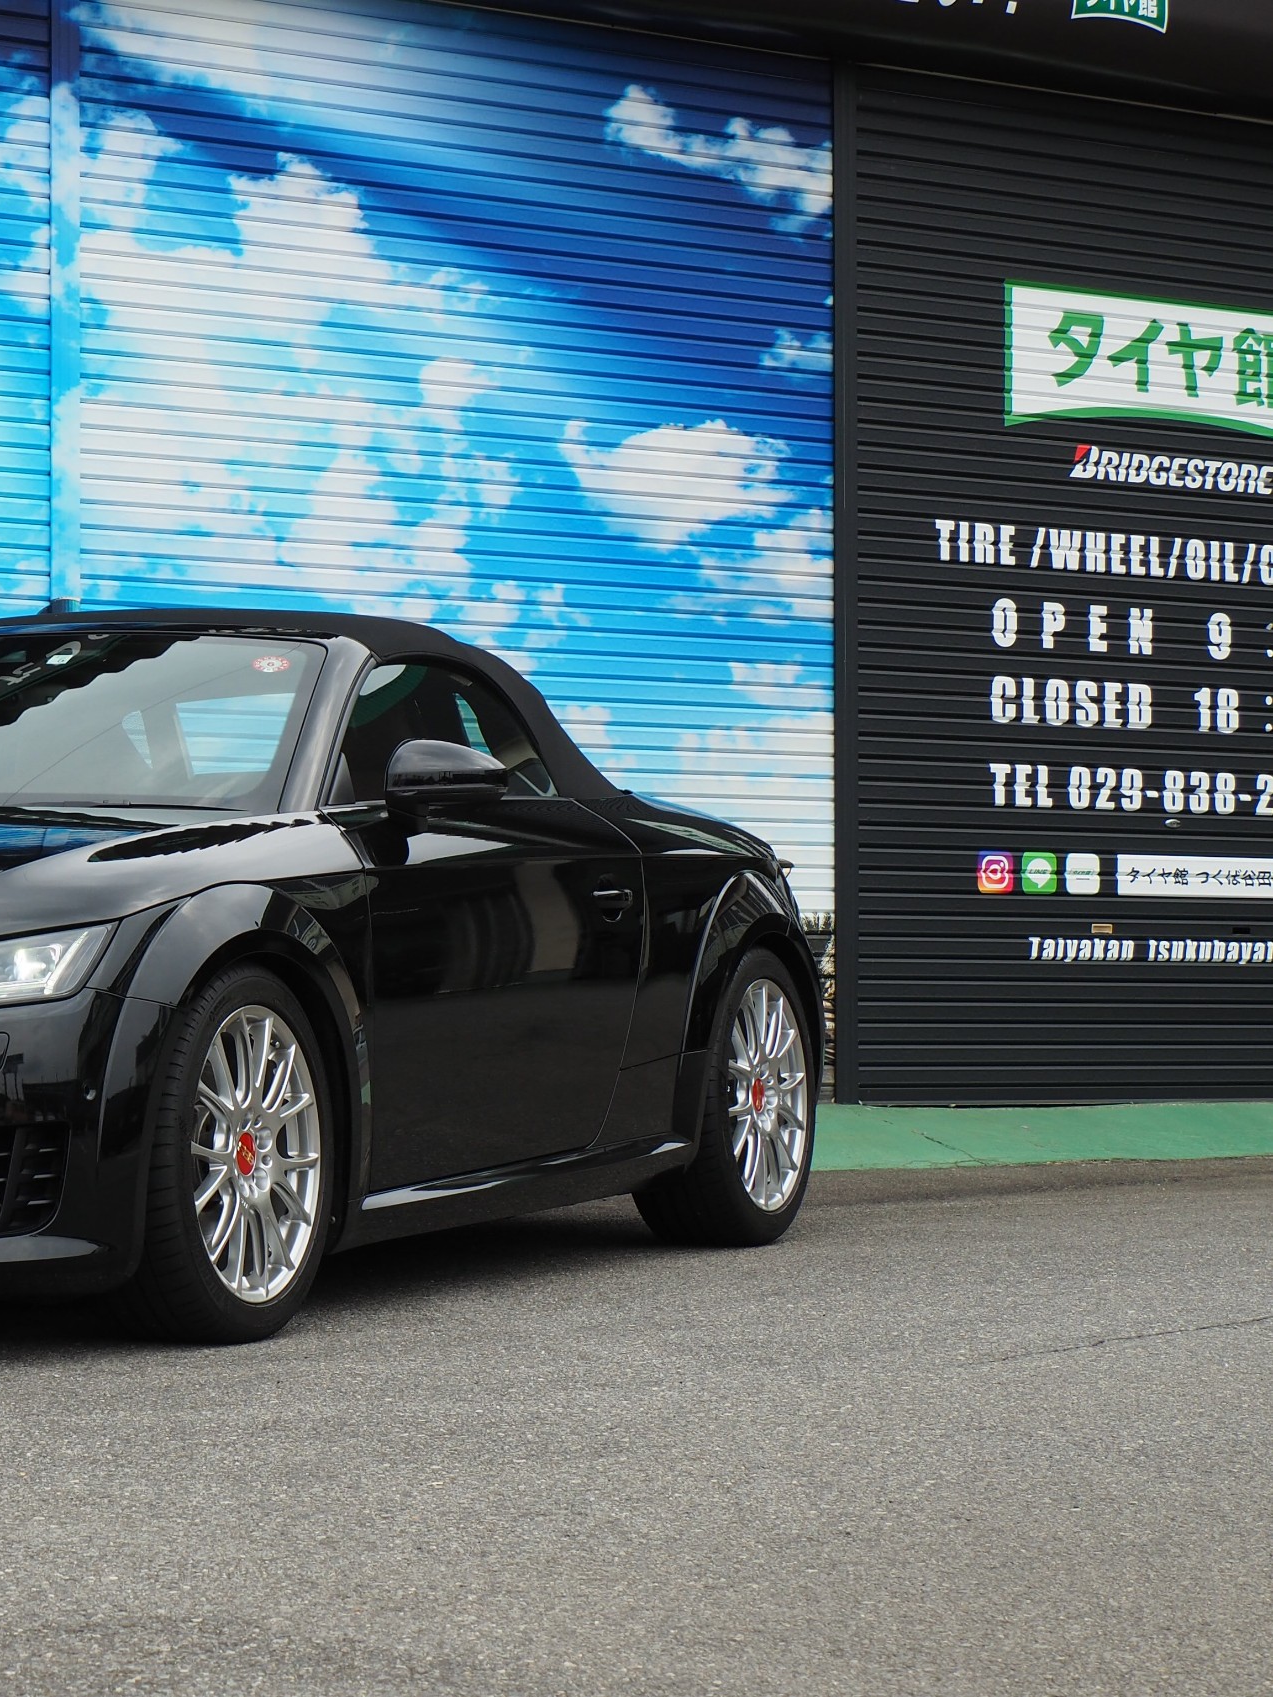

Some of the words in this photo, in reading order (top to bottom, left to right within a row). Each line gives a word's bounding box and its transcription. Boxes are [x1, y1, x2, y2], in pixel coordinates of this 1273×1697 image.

[1047, 311, 1273, 408] タイヤ館
[1070, 445, 1273, 495] BRIDGESTONE
[935, 519, 1016, 565] TIRE
[992, 597, 1153, 655] OPEN
[1207, 612, 1232, 660] 9
[990, 675, 1152, 730] CLOSED
[1194, 687, 1239, 733] 18
[989, 763, 1053, 807] TEL
[1068, 766, 1273, 816] 029-838-2
[1127, 867, 1189, 886] タイヤ館
[1195, 869, 1273, 887] つくば谷田
[1028, 937, 1134, 962] Taiyakan
